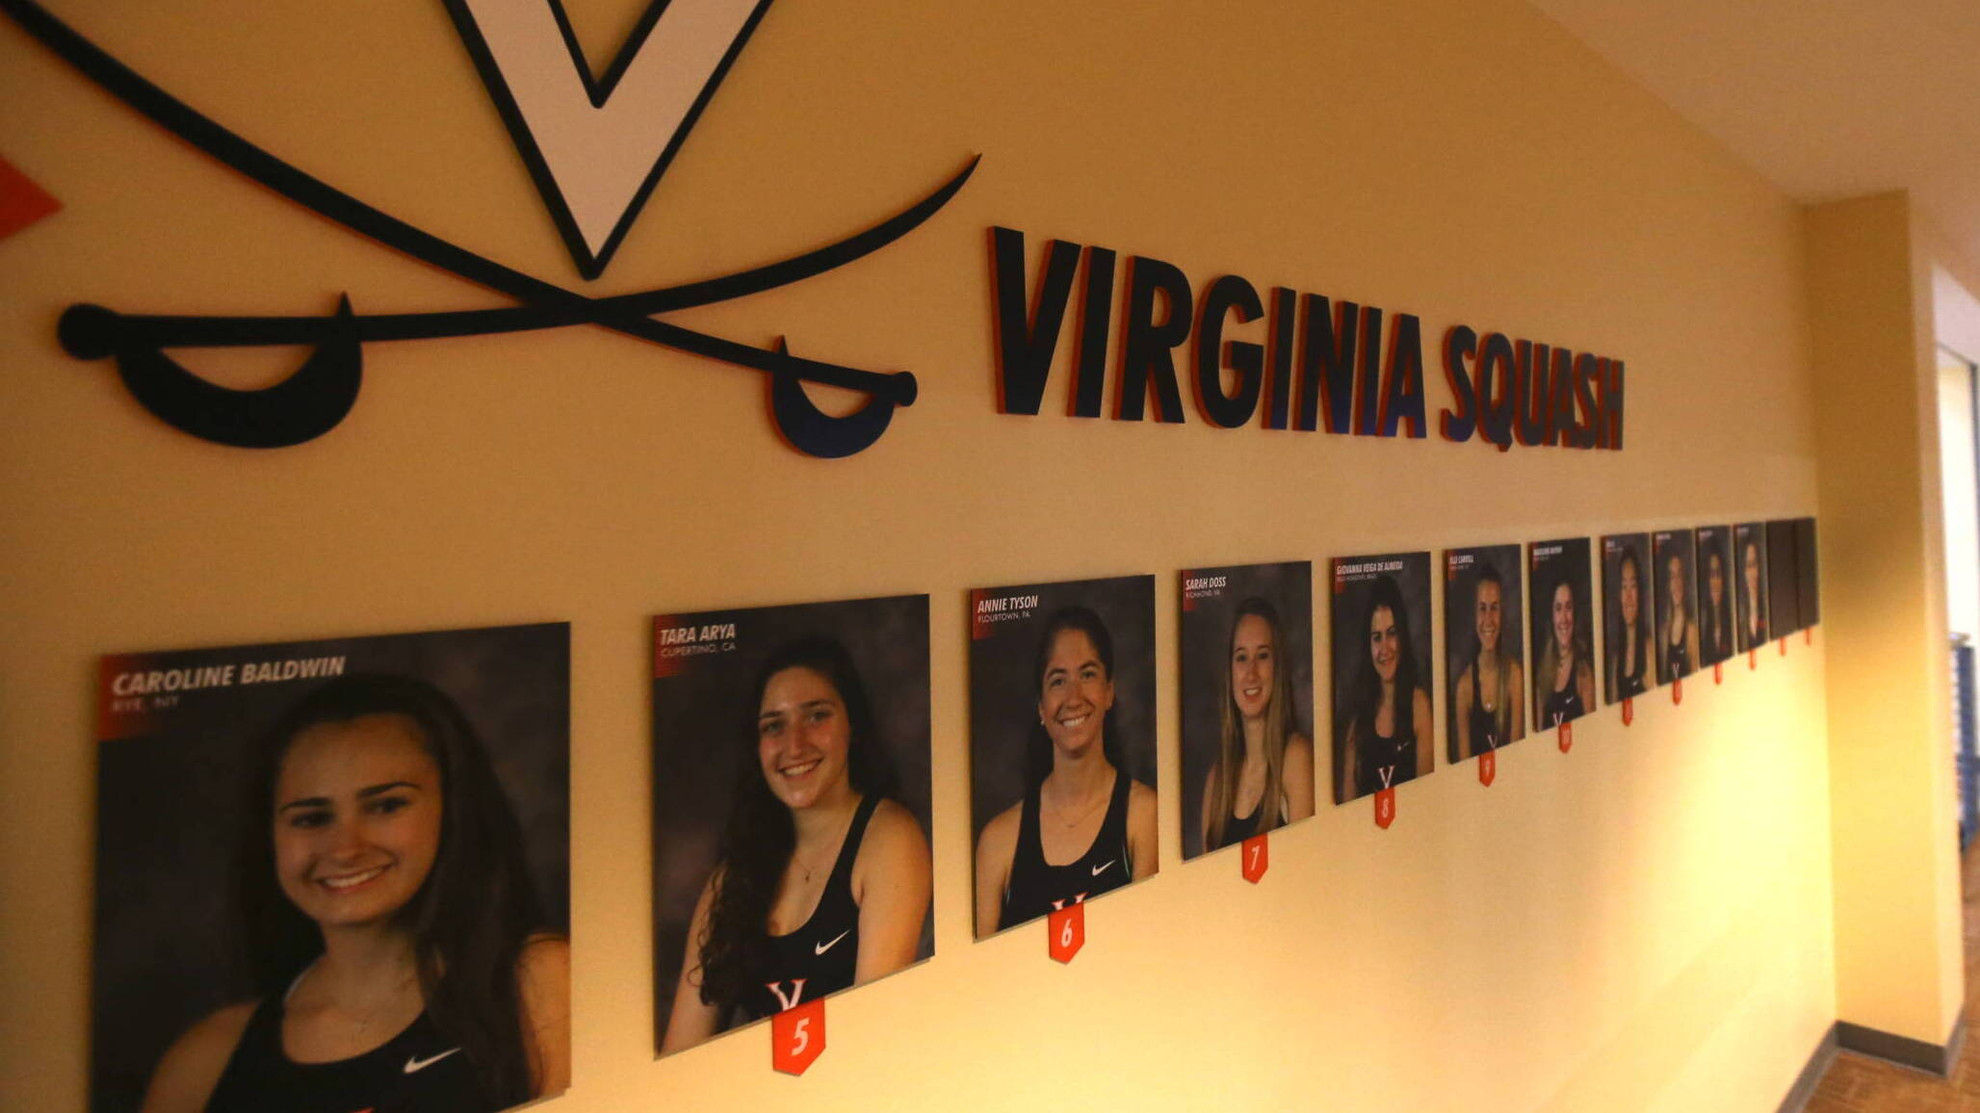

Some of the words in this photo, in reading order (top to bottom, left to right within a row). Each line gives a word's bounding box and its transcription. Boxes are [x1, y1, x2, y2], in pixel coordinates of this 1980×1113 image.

[987, 226, 1427, 438] VIRGINIA
[1440, 325, 1624, 452] SQUASH
[1186, 578, 1208, 590] SARAH
[1209, 576, 1226, 588] DOSS
[978, 598, 1008, 613] ANNIE
[1009, 594, 1039, 610] TYSON
[660, 626, 697, 645] TARA
[699, 623, 736, 641] ARYA
[722, 641, 736, 652] CA
[112, 665, 236, 697] CAROLINE
[240, 655, 346, 685] BALDWIN
[1382, 798, 1390, 818] 8
[1251, 845, 1260, 871] 7
[1061, 918, 1073, 948] 6
[791, 1017, 810, 1056] 5
